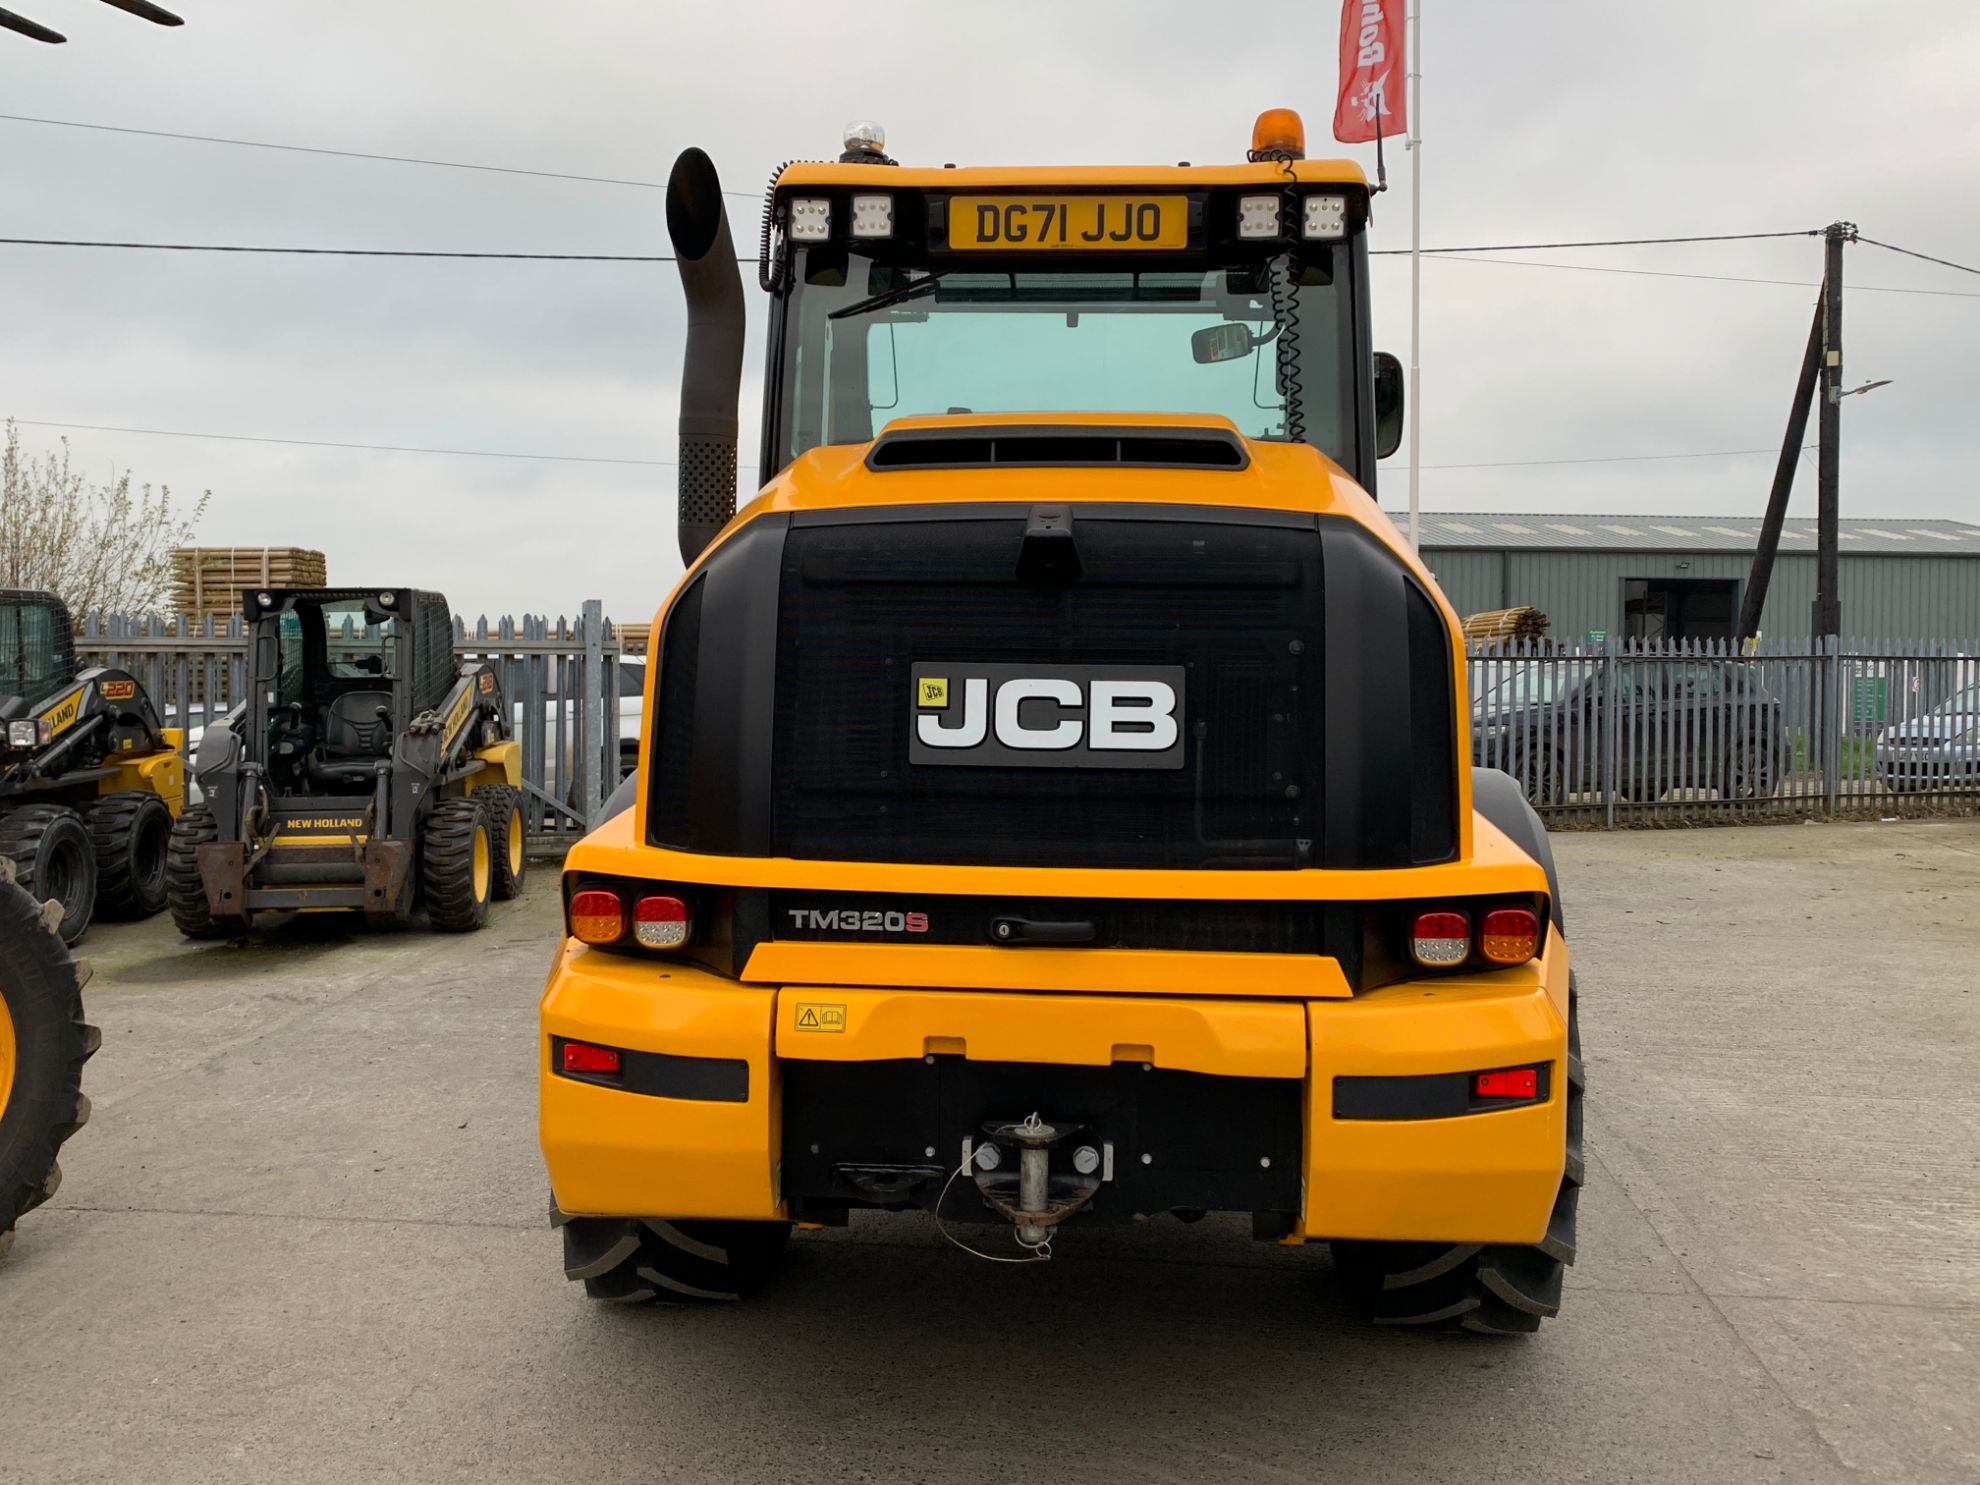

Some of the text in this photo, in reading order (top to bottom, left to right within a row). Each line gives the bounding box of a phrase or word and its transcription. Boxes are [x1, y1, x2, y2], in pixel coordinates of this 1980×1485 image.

[976, 203, 1160, 242] DG71 JJO
[101, 681, 134, 698] L220
[926, 685, 944, 699] JCB
[47, 703, 74, 728] LAND
[917, 678, 1178, 749] JCB
[287, 818, 363, 828] NEW HOLLAND
[788, 909, 929, 932] TM320S
